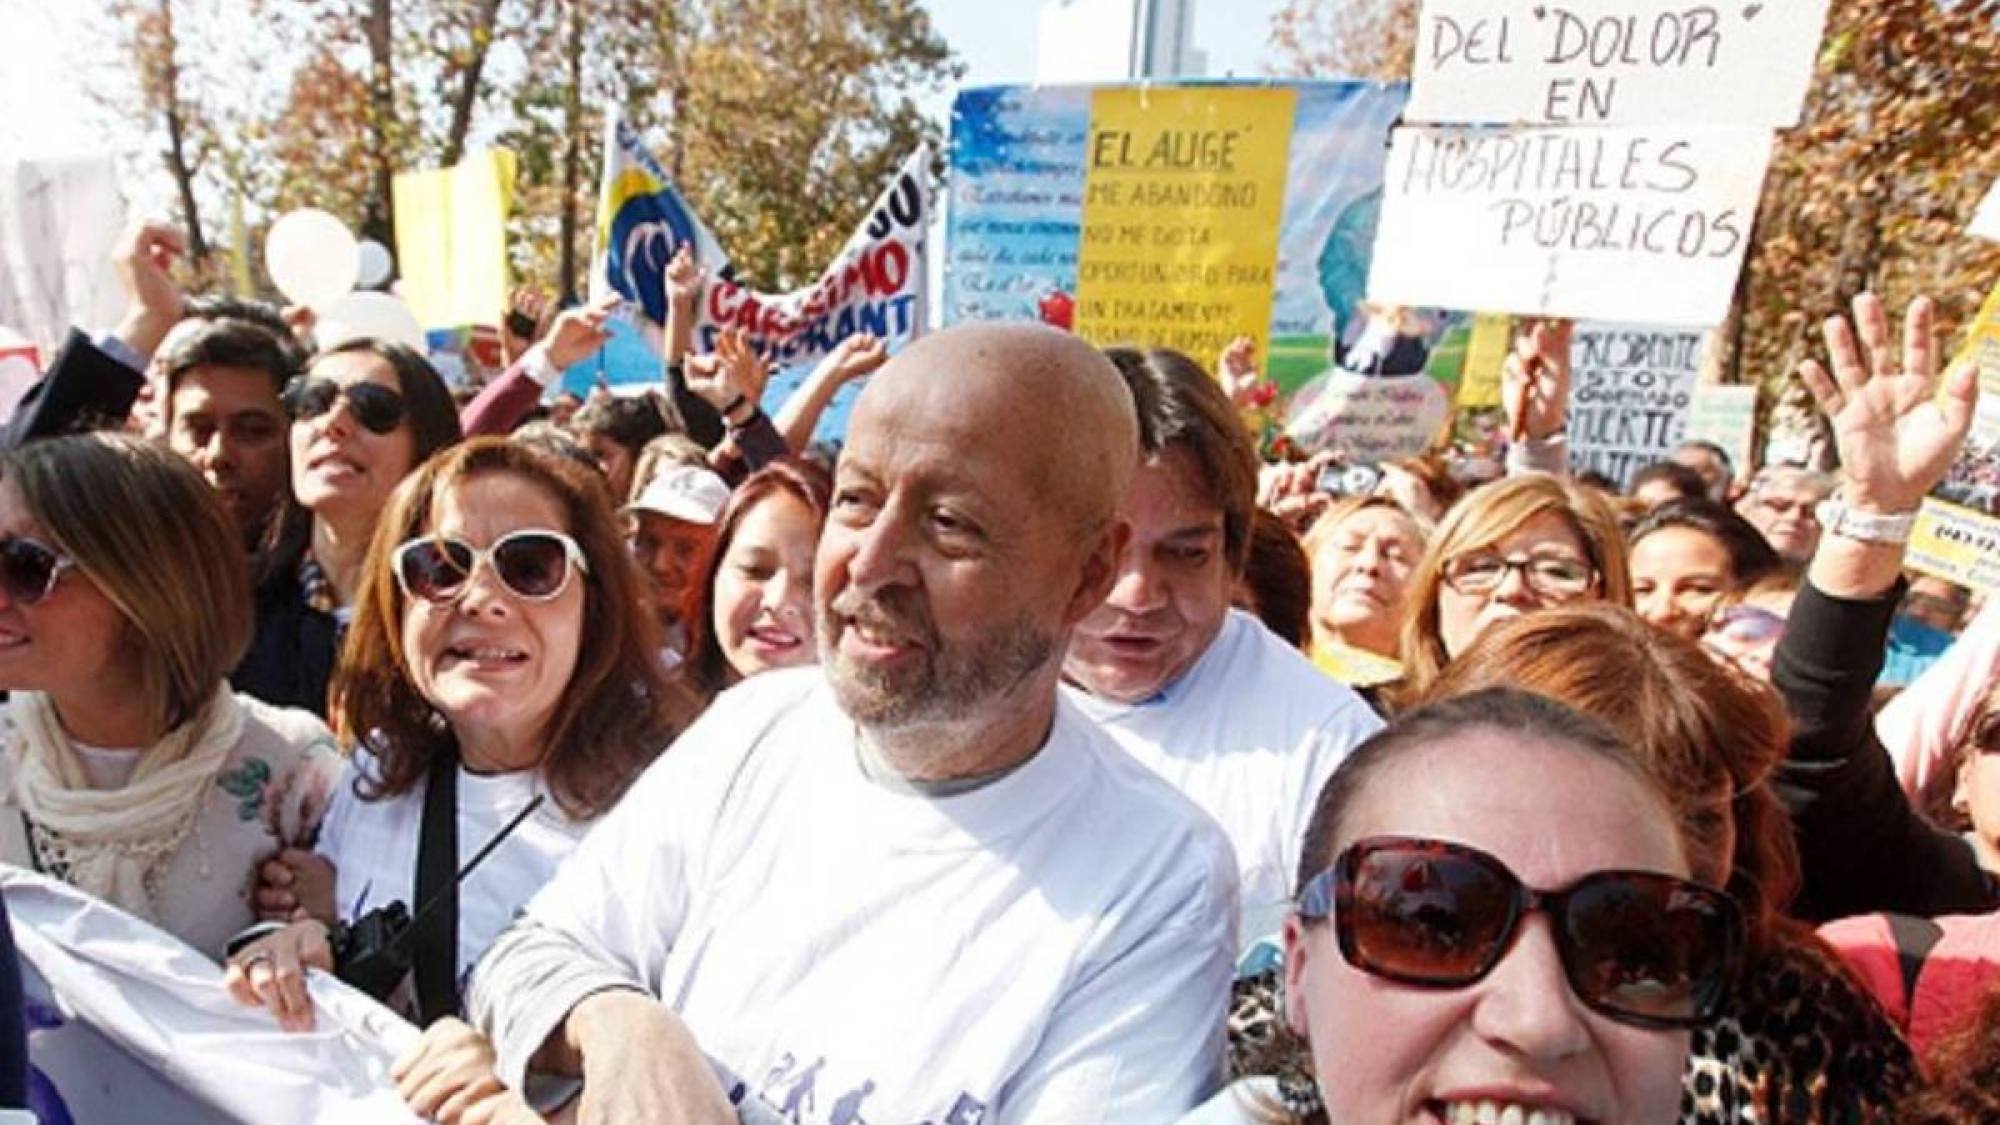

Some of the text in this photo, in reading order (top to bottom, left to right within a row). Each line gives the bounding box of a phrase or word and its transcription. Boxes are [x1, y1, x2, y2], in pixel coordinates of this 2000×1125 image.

[1432, 15, 1513, 70] DEL
[1544, 78, 1617, 122] EN
[1402, 134, 1698, 194] HOSPITALES
[1088, 181, 1120, 206] ME
[1084, 225, 1114, 245] NO
[1119, 225, 1144, 246] ME
[1494, 196, 1742, 259] PÚBLICOS
